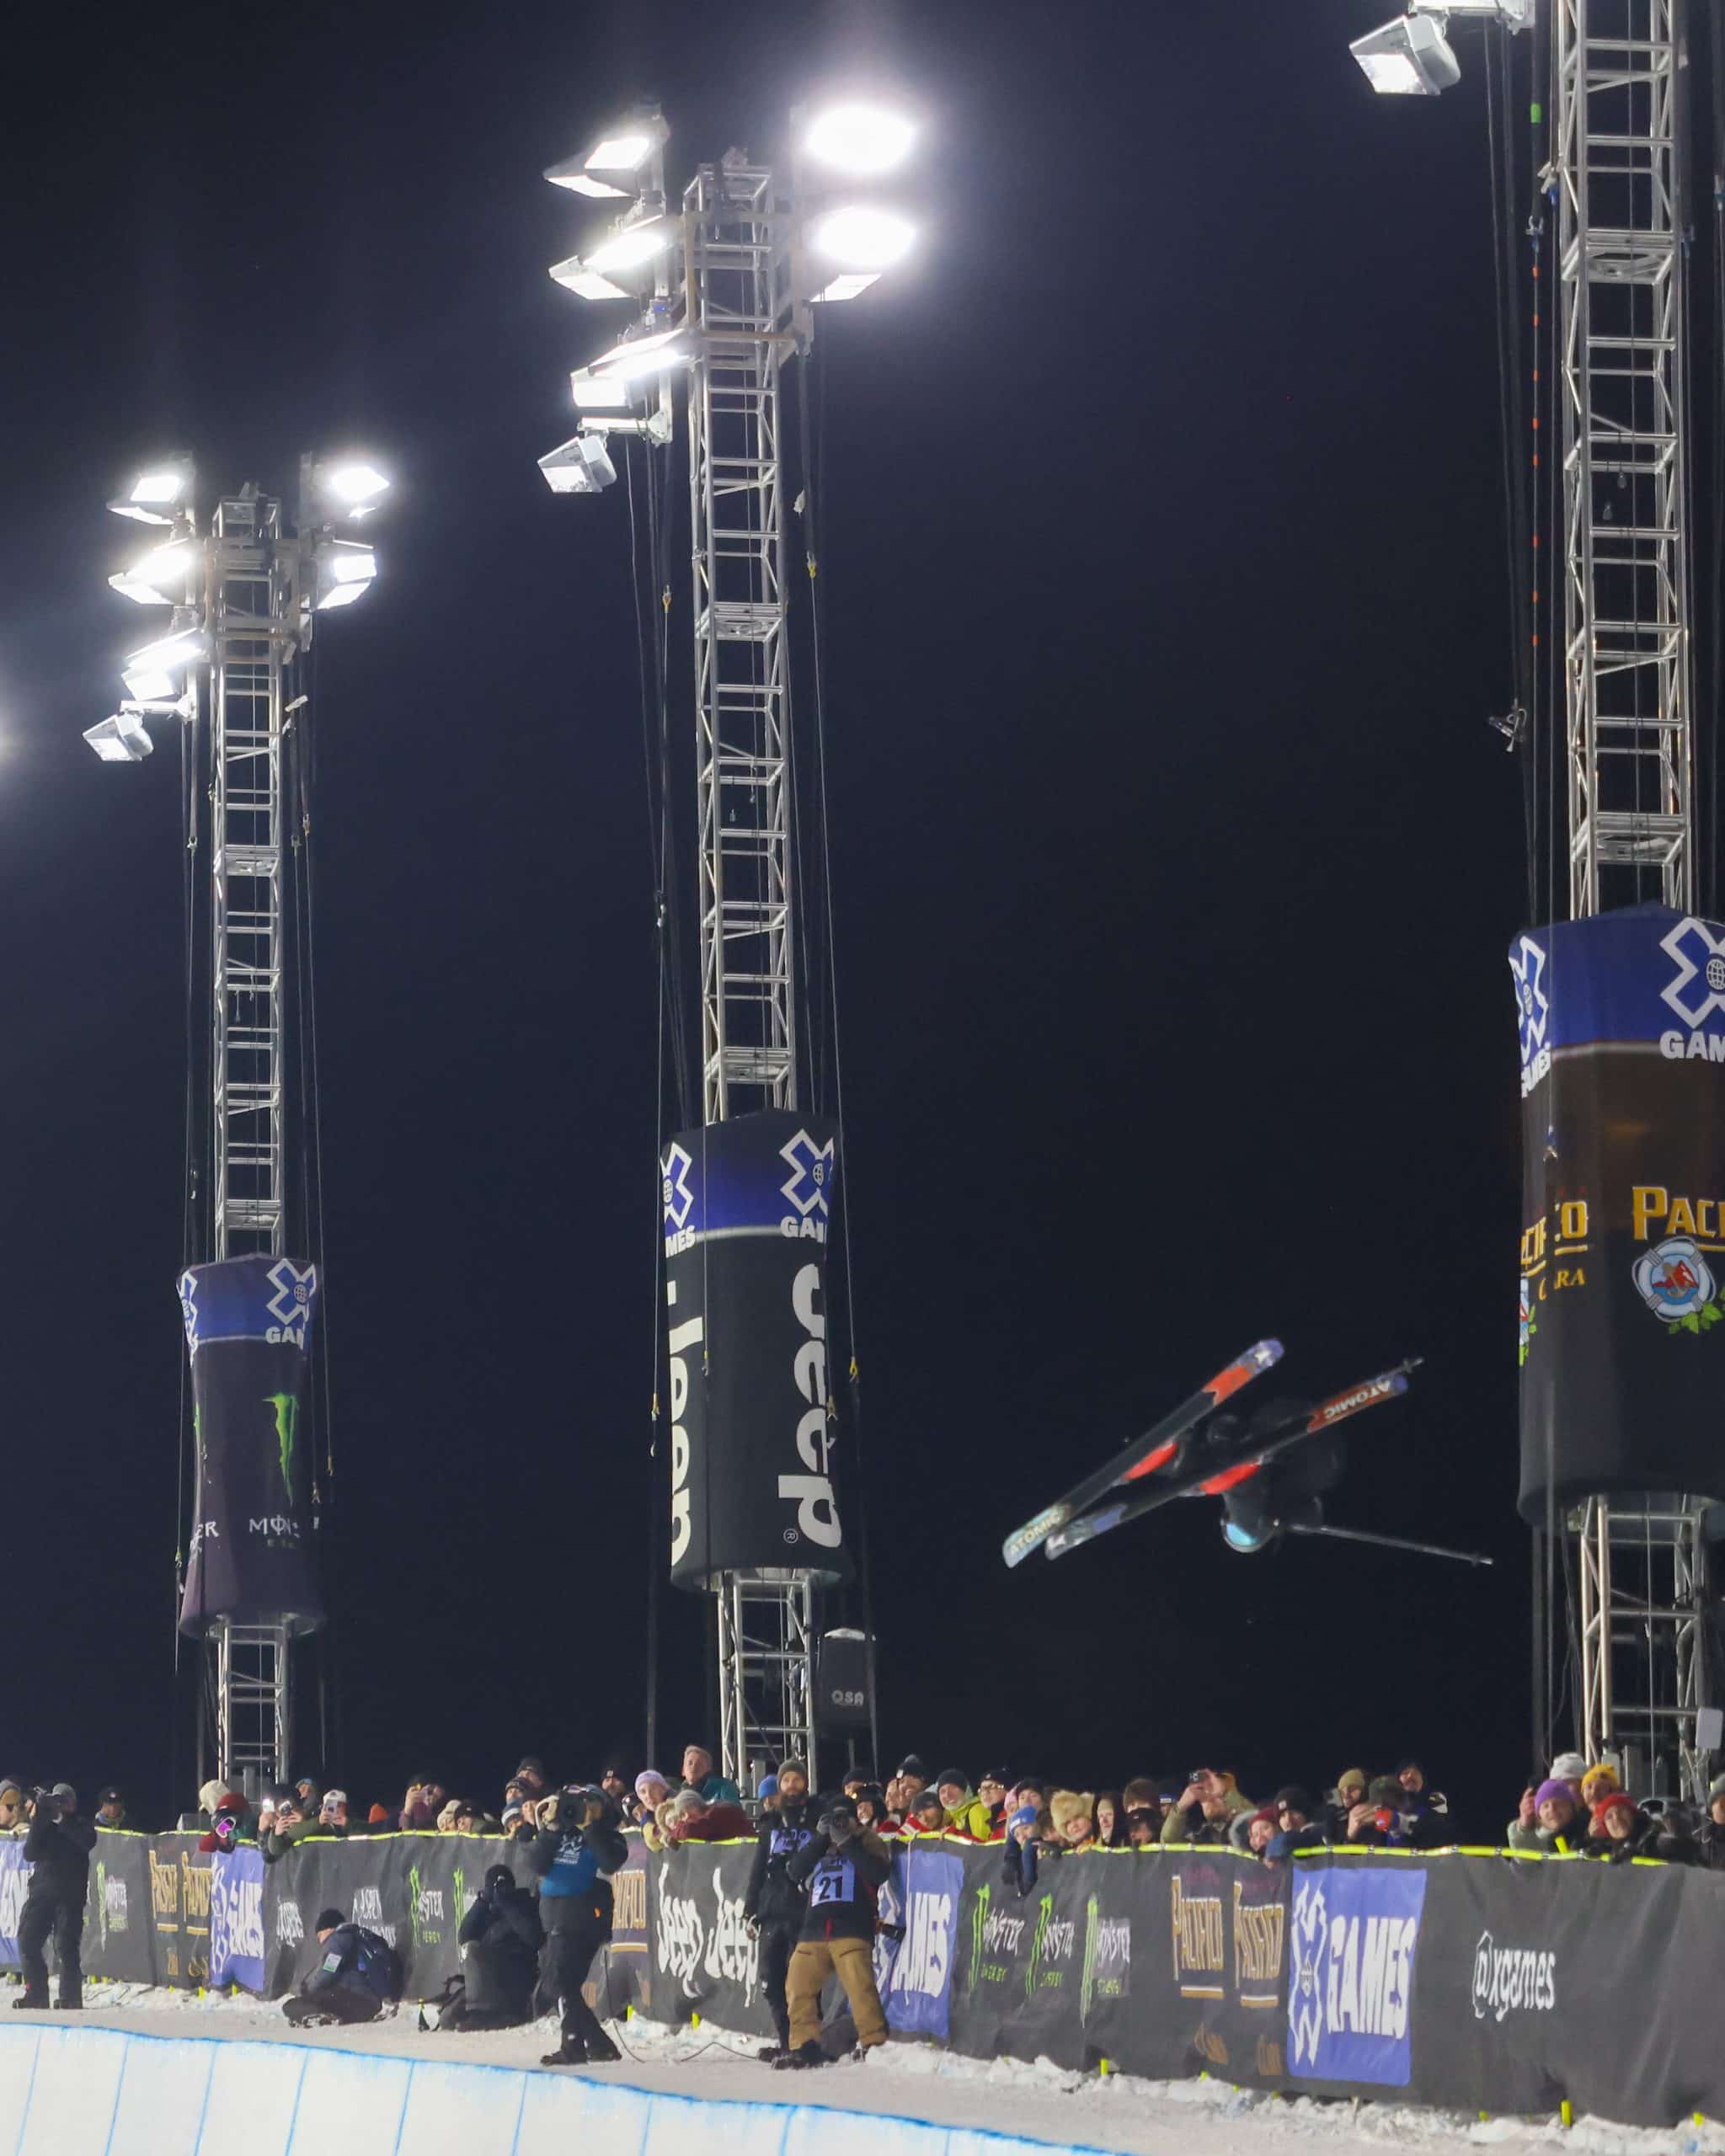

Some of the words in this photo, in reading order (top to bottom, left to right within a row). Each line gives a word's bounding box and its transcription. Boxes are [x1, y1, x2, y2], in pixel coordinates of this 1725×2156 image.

[1323, 1380, 1391, 1420] ATOMIC
[656, 1863, 704, 1999] Jeep
[819, 1876, 843, 1902] 21
[1327, 1914, 1417, 2040] GAMES
[1471, 1929, 1556, 2021] @xgames
